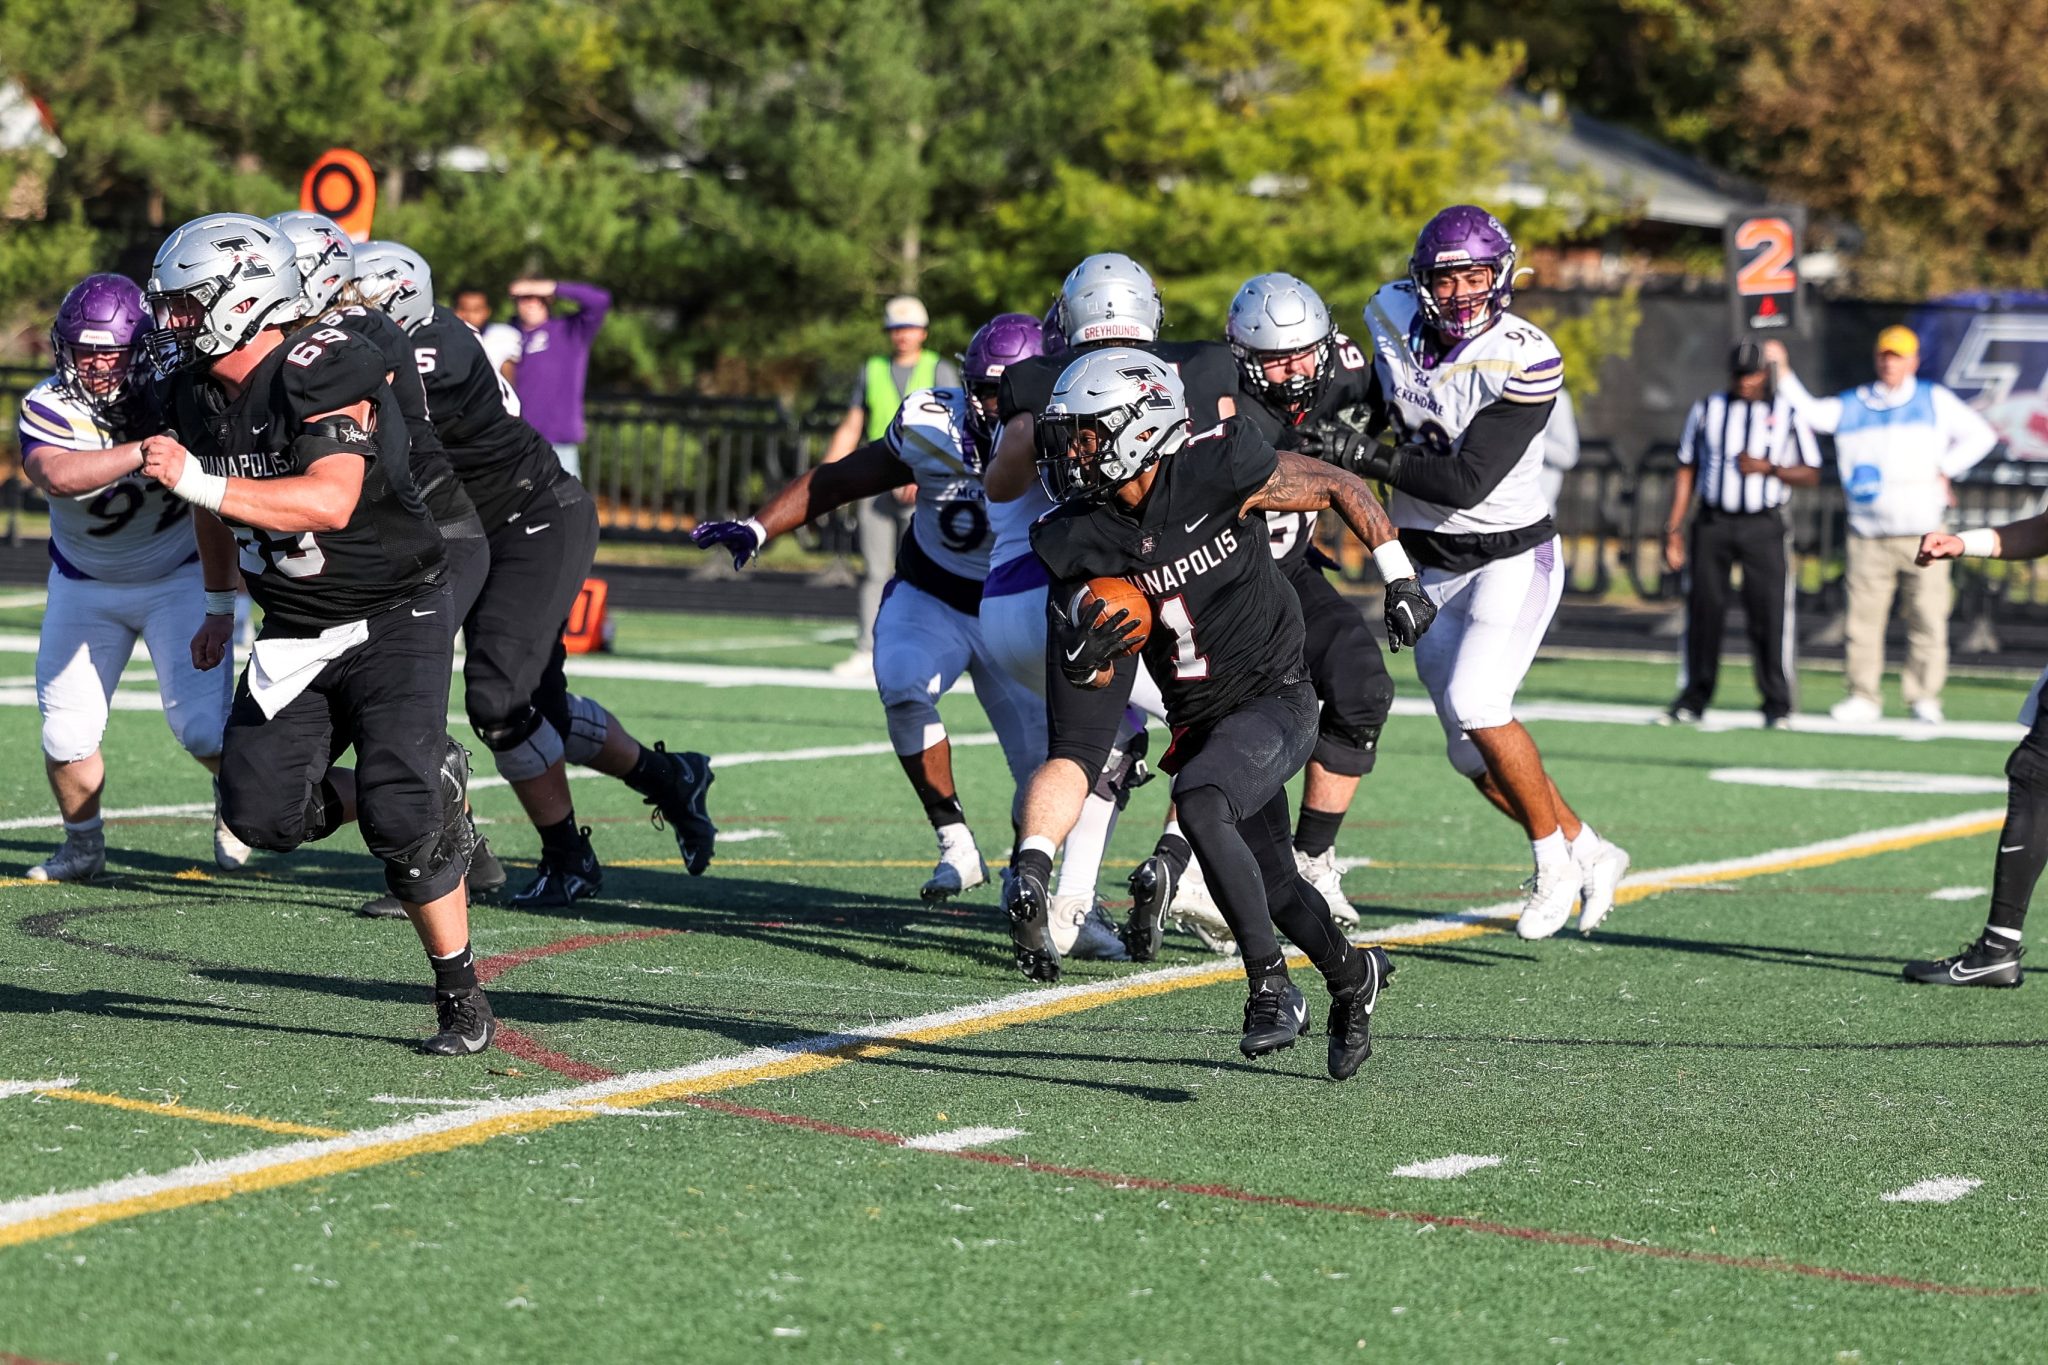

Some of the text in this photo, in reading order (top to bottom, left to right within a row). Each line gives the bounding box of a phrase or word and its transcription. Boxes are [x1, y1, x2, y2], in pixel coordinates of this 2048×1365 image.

[1735, 217, 1796, 296] 2
[287, 328, 349, 368] 69
[1084, 324, 1141, 340] GREYHOUNDS
[1159, 593, 1210, 680] 1
